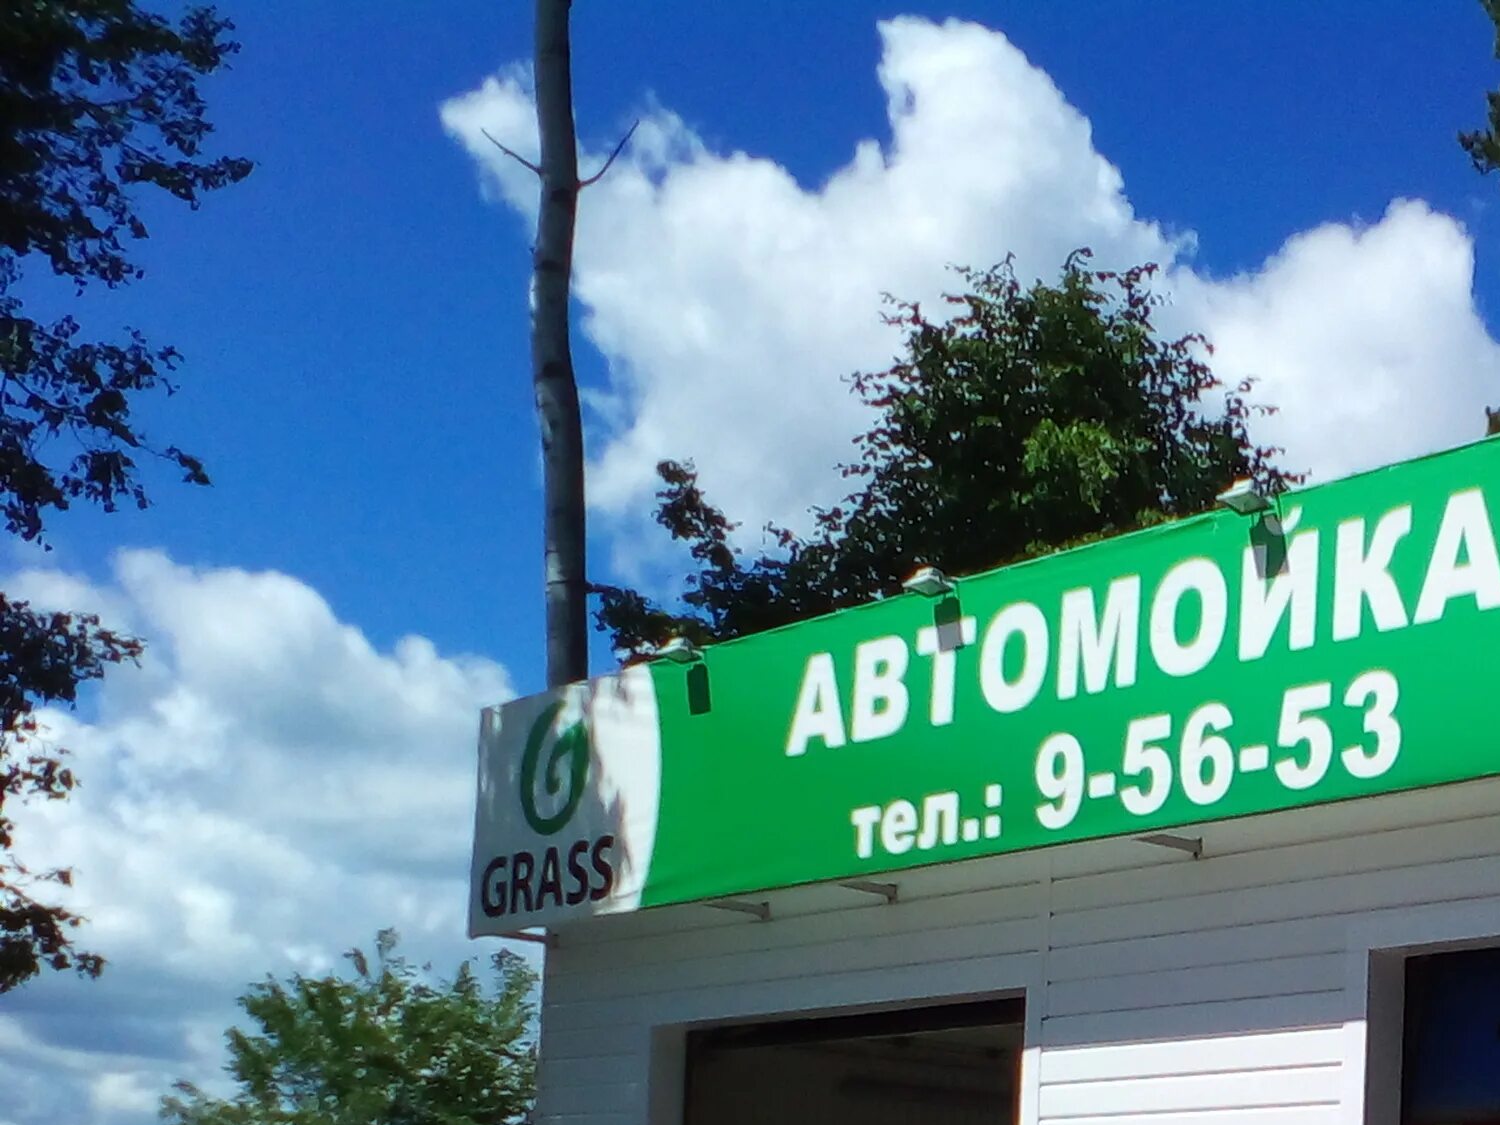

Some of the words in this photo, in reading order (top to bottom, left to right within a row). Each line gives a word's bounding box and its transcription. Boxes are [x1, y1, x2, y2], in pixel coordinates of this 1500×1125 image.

[852, 784, 1001, 859] тел.:
[1034, 670, 1402, 829] 9-56-53
[481, 835, 614, 918] GRASS
